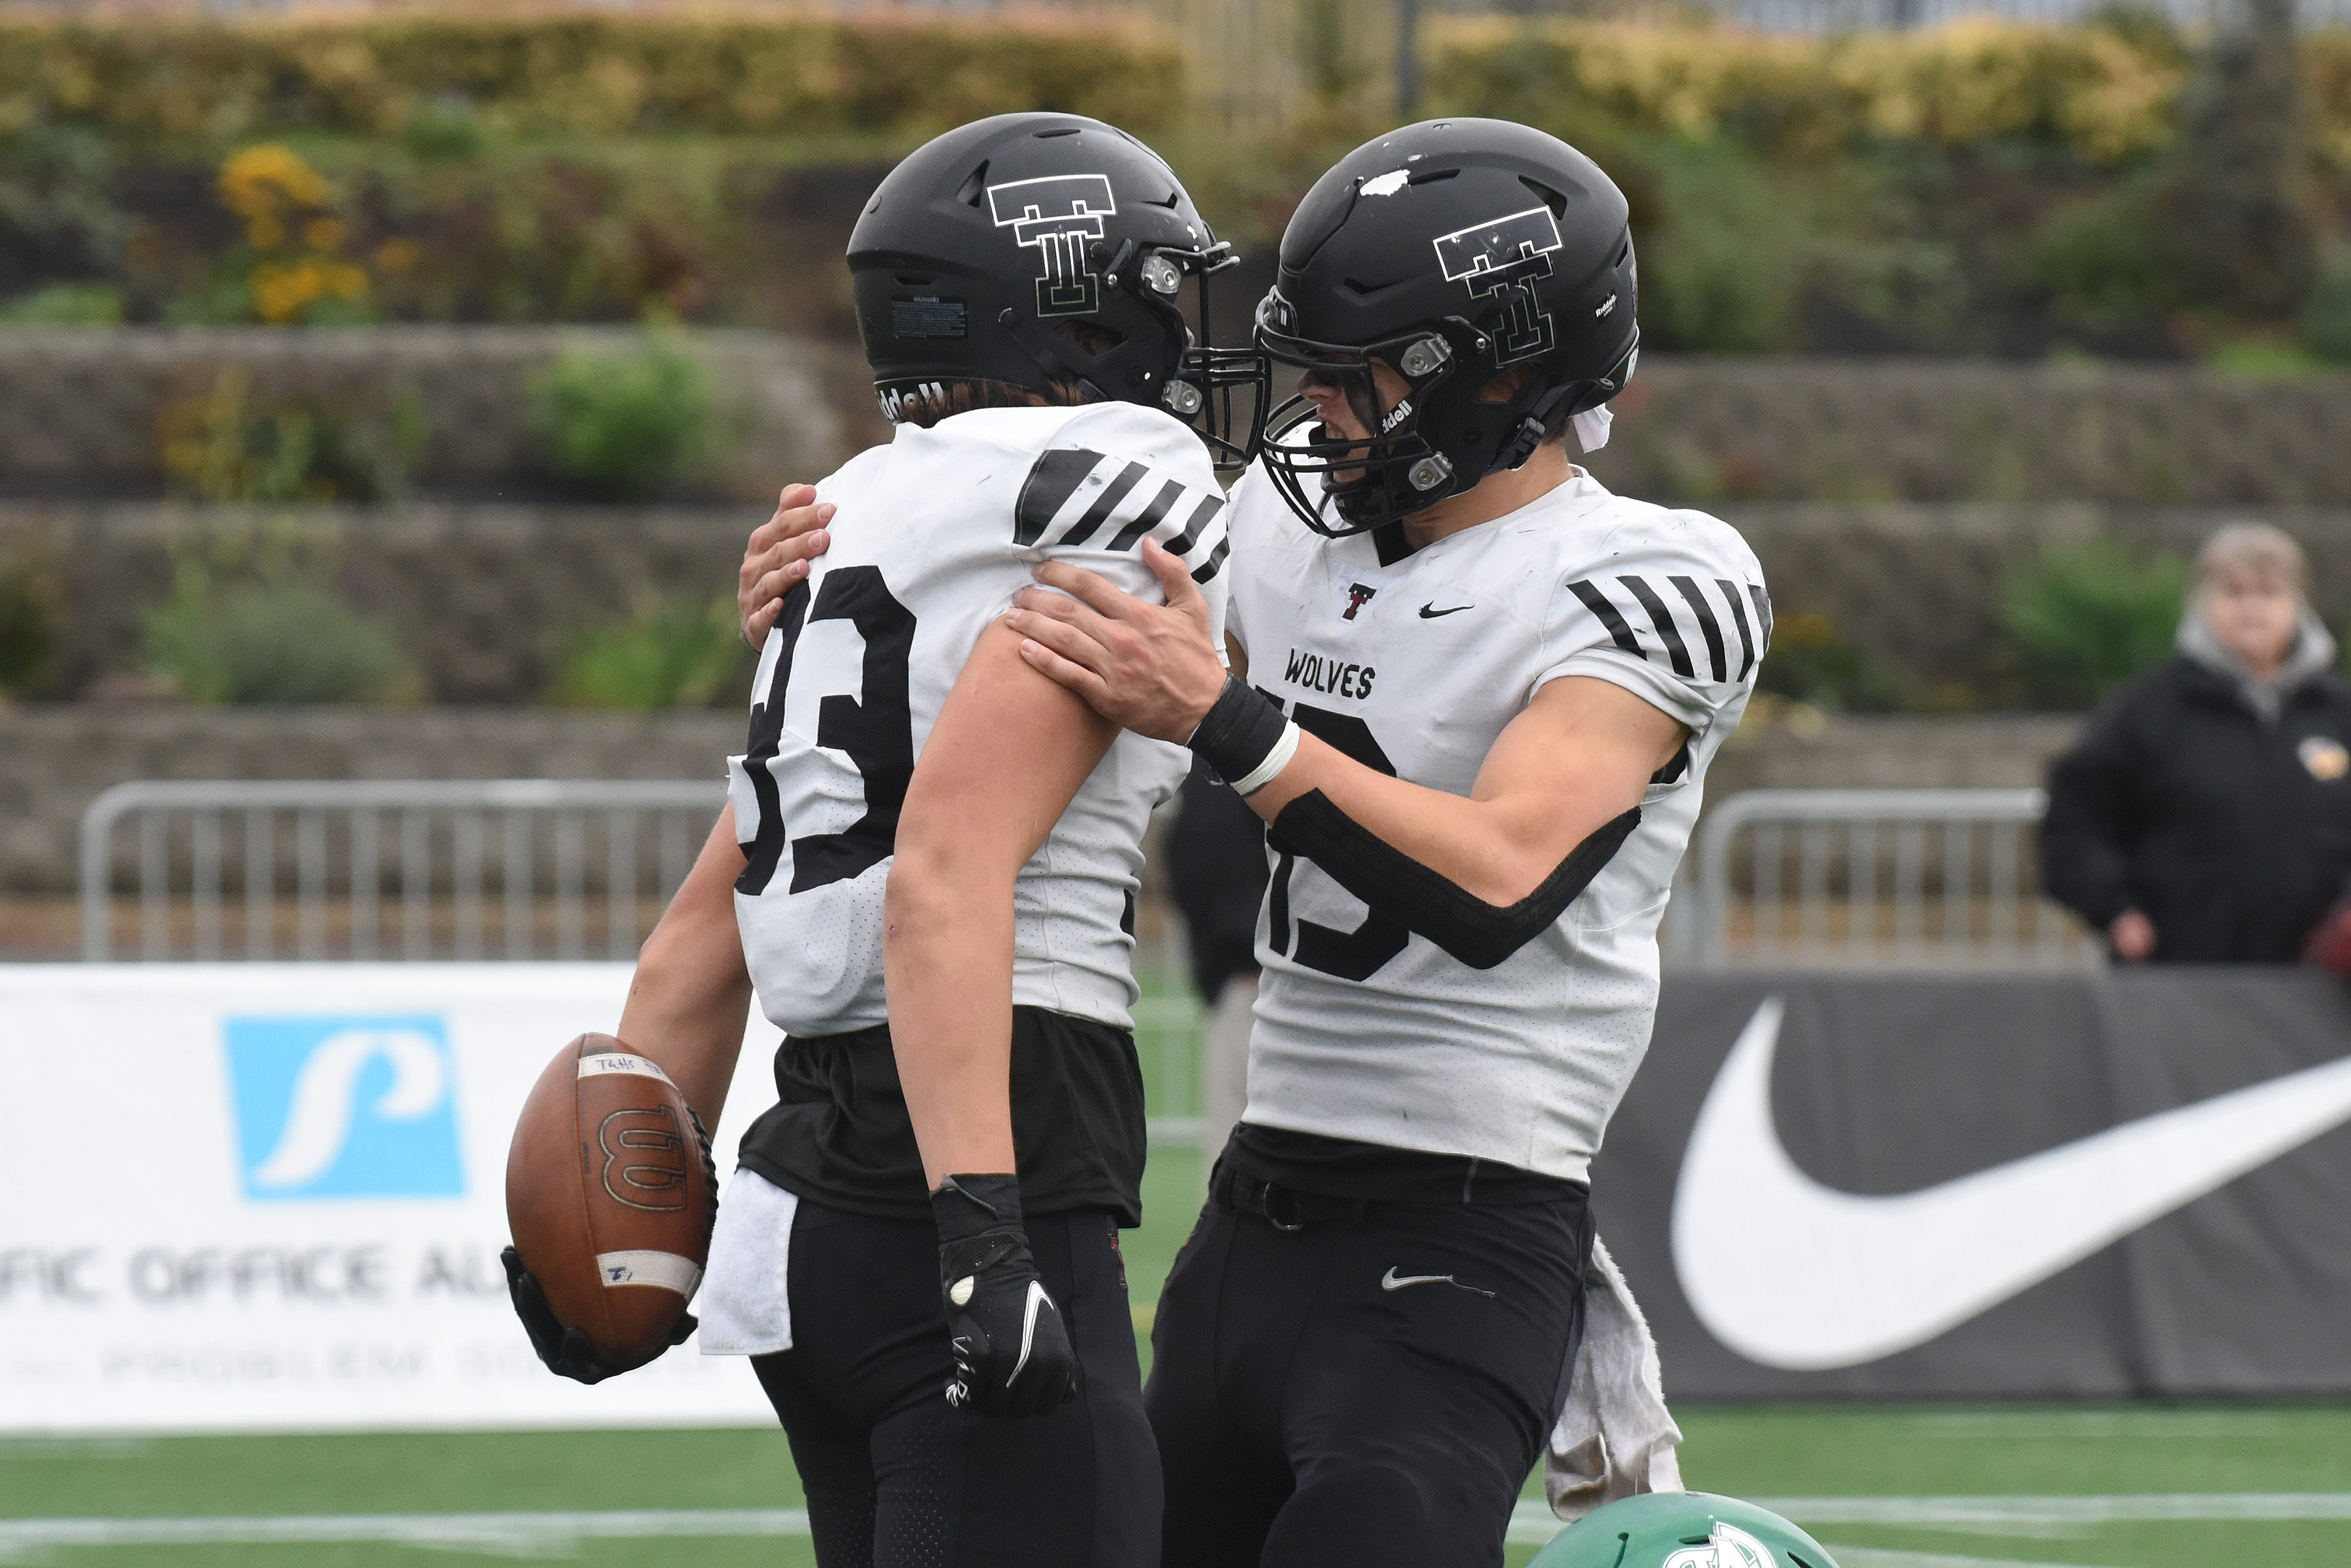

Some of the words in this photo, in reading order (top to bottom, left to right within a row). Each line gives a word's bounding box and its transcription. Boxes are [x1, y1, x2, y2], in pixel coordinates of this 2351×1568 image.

[1595, 294, 1616, 317] Riddell
[878, 382, 943, 426] ddell
[1382, 400, 1413, 434] ddell
[1284, 648, 1376, 699] WOLVES
[129, 1245, 388, 1302] OFFICE
